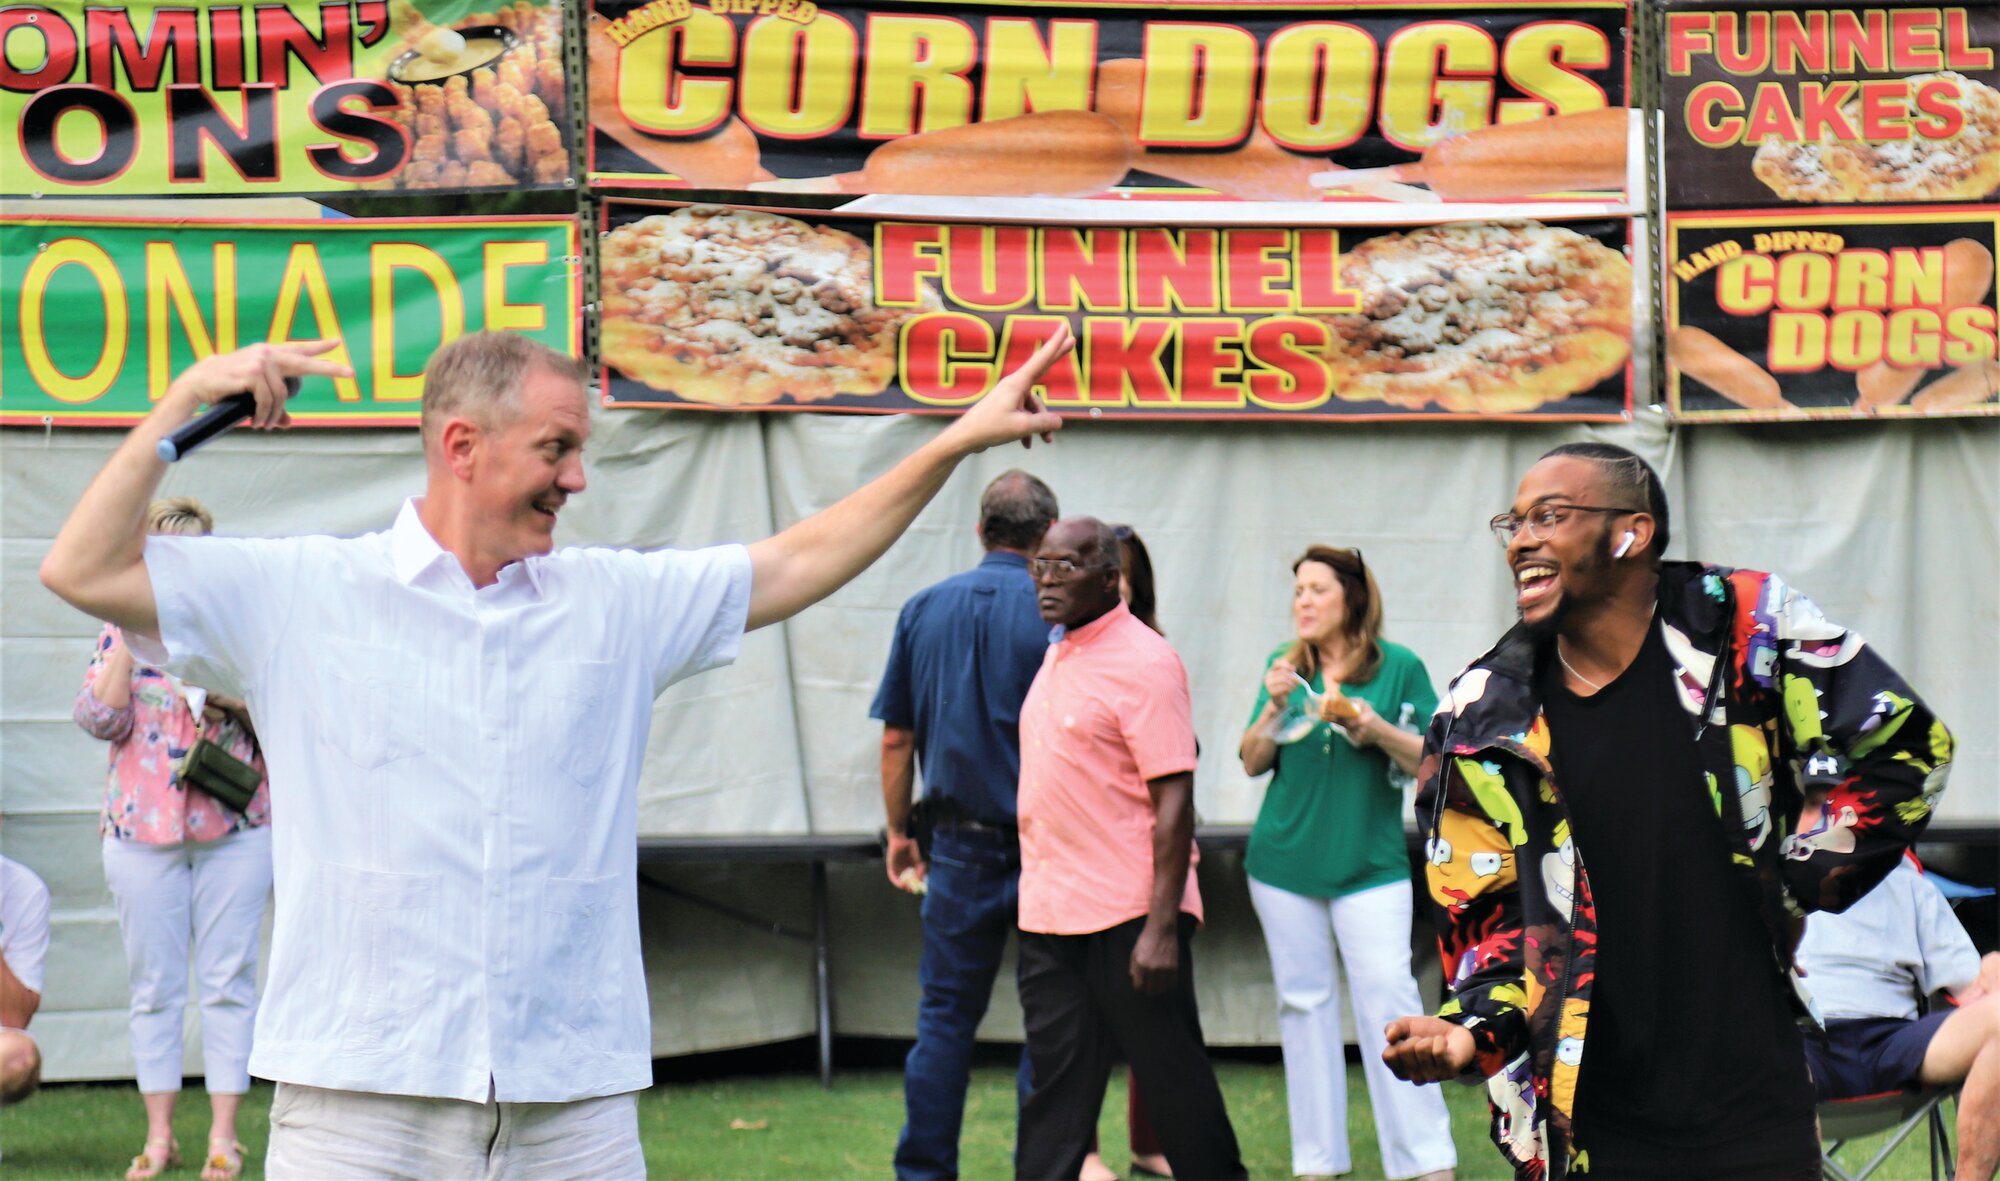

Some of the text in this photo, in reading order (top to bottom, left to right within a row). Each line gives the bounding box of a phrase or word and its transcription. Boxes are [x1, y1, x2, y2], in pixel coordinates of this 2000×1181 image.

[605, 0, 818, 48] HAND DIPPED
[1665, 8, 1994, 76] FUNNEL
[617, 8, 1611, 152] CORN DOGS
[1684, 80, 1966, 149] CAKES
[17, 79, 412, 186] ONS
[873, 221, 1362, 314] FUNNEL
[1672, 231, 1844, 283] HAND DIPPED
[1716, 246, 1947, 316] CORN
[899, 312, 1334, 410] CAKES
[1767, 305, 1998, 372] DOGS
